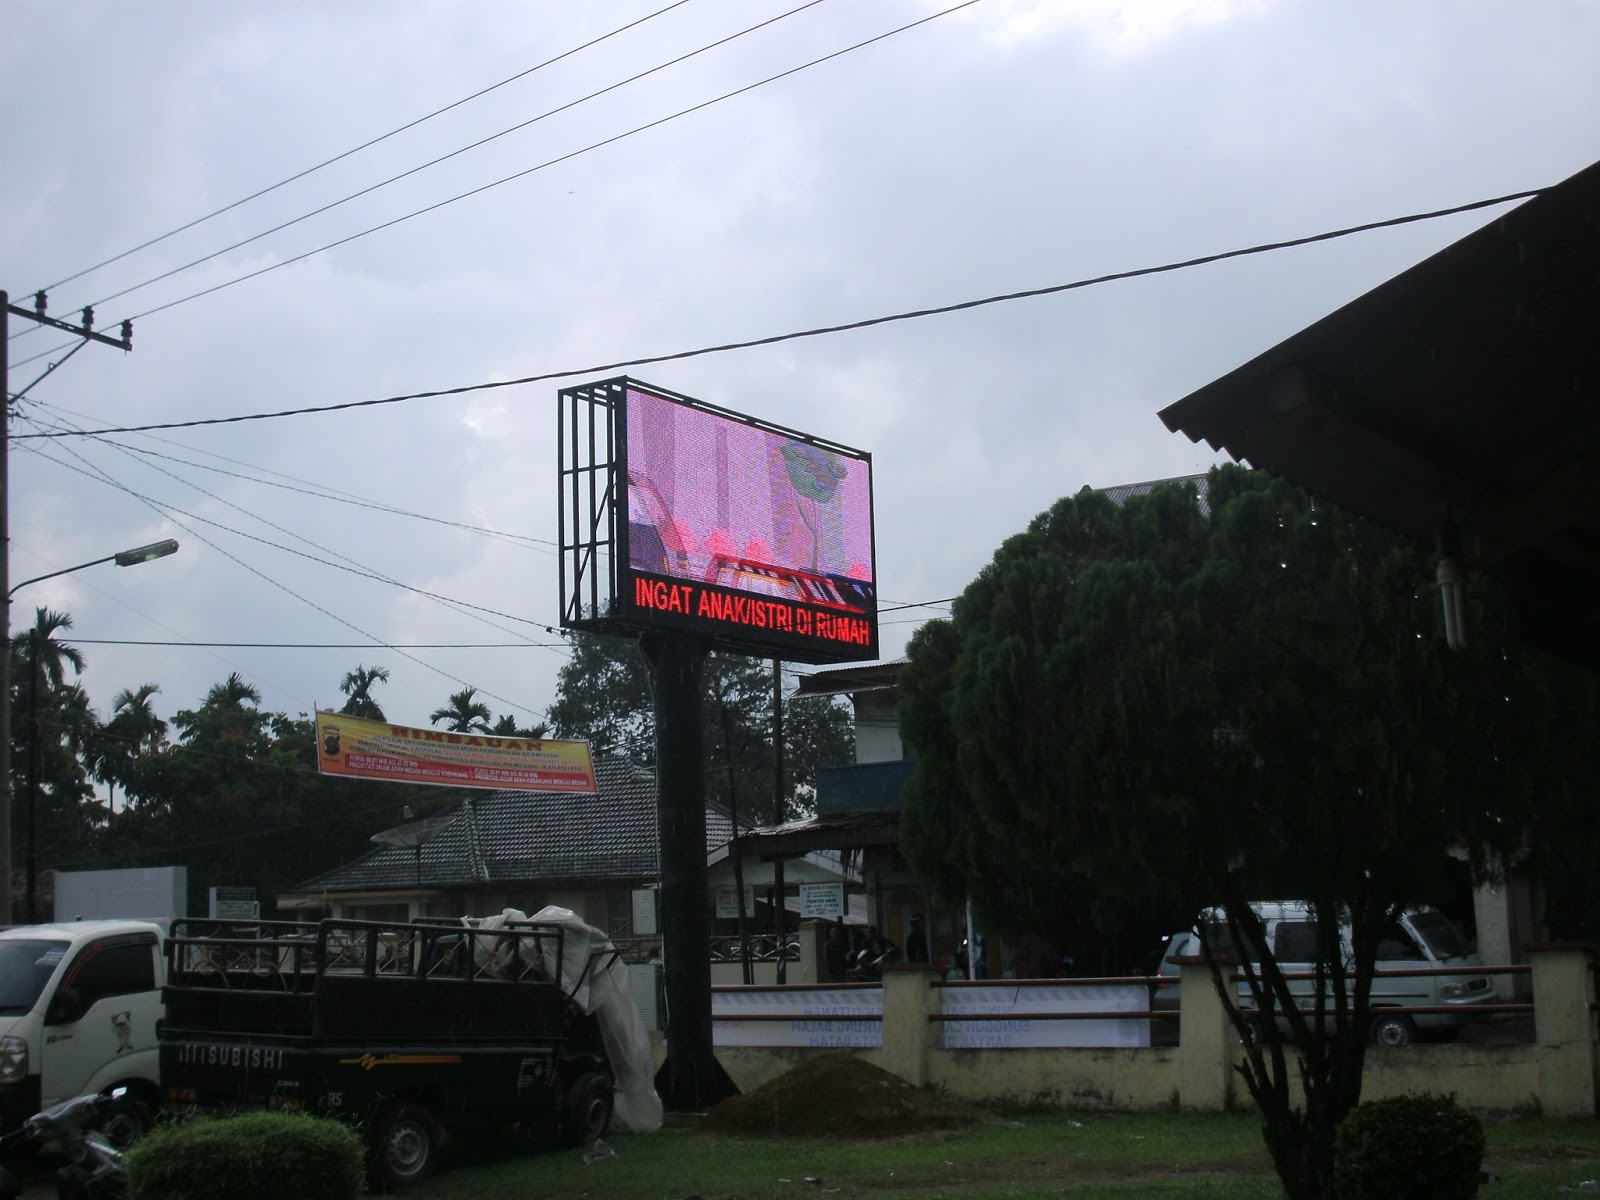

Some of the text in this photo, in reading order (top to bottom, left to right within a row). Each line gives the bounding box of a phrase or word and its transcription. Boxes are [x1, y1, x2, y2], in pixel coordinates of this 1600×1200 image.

[635, 577, 870, 645] INGAT ANAK/ISTRI DI RUMAH
[391, 727, 543, 752] HIMBAUAN
[438, 743, 478, 752] PENGEMUDI
[479, 748, 520, 756] KENDARAAN
